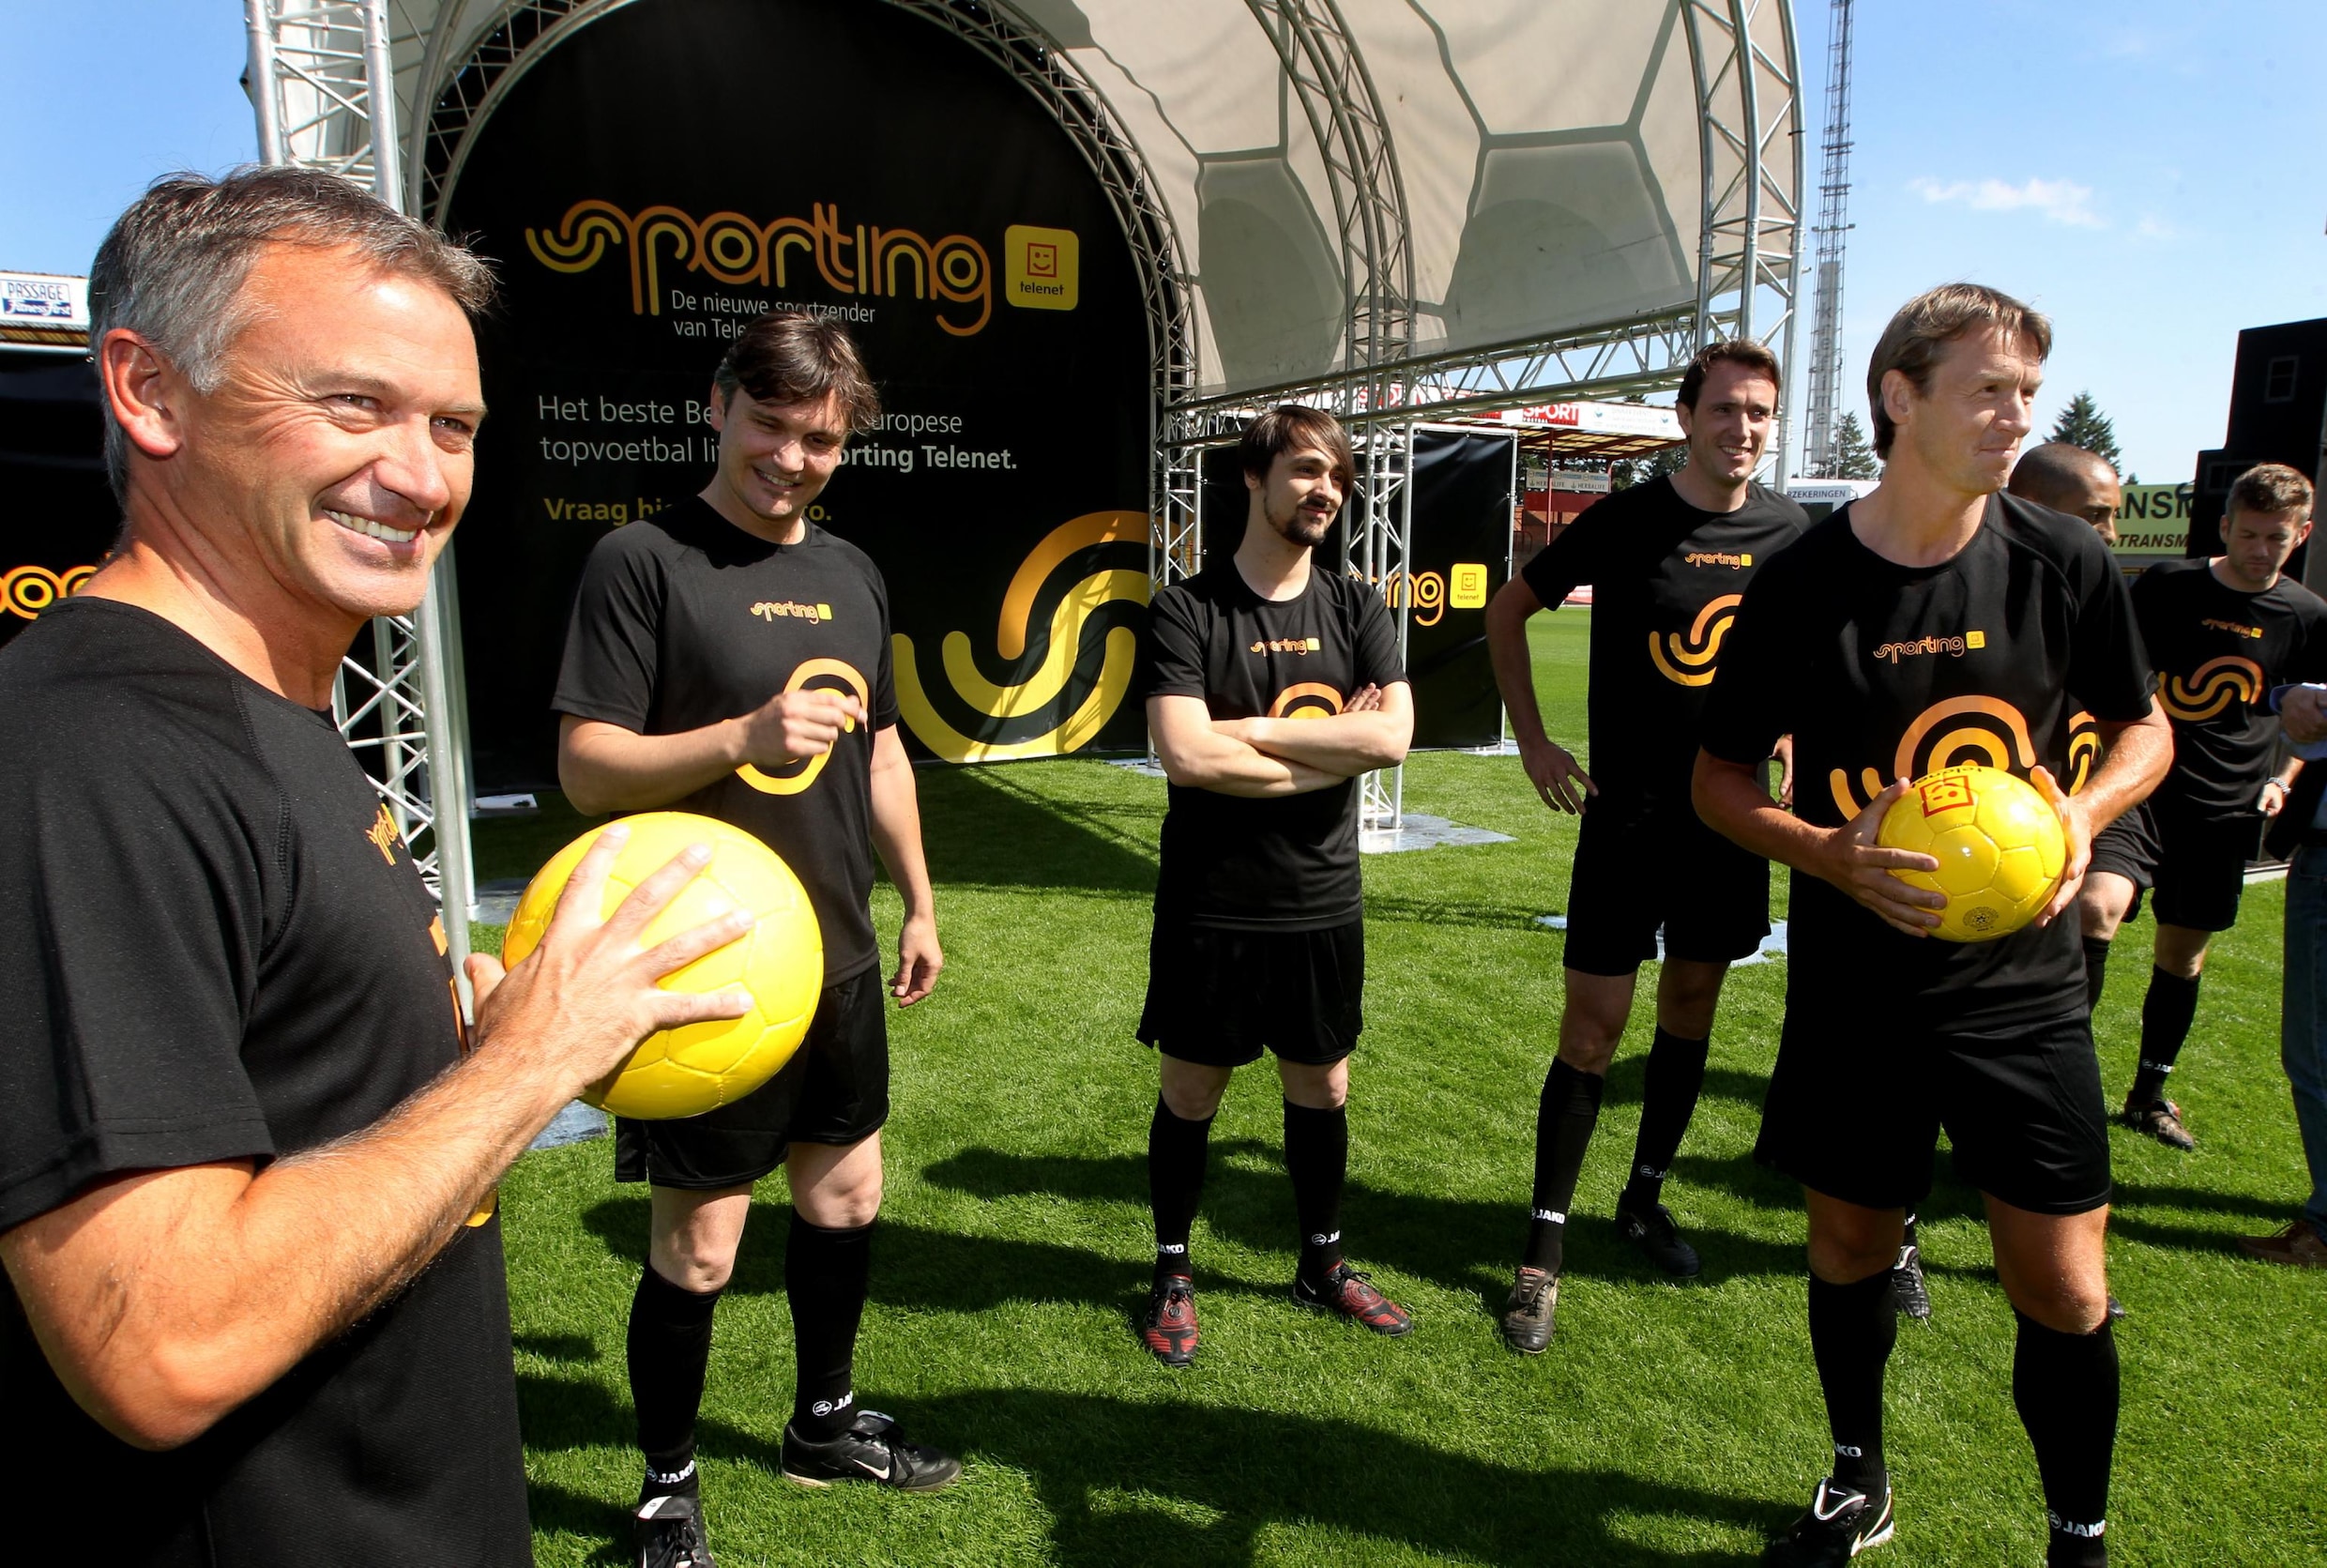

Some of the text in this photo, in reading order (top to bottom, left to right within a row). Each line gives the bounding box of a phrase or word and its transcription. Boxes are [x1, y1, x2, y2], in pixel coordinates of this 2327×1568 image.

[525, 200, 992, 337] sporting
[8, 282, 64, 300] PASSAGE
[1020, 281, 1065, 296] telenet
[671, 290, 696, 311] De
[704, 293, 768, 314] nieuwe
[674, 318, 747, 340] van Tele
[538, 395, 590, 421] Het
[600, 395, 675, 424] beste
[872, 412, 963, 437] uropese
[1524, 403, 1579, 420] SPORT
[540, 435, 692, 466] topvoetbal
[838, 443, 914, 473] orting
[921, 445, 1017, 469] Telenet.
[543, 497, 629, 525] Vraag
[1684, 552, 1741, 571] sporting
[750, 601, 819, 625] sporting
[1250, 638, 1308, 657] sporting
[1873, 635, 1965, 664] sporting
[1536, 1209, 1565, 1225] JAKO
[1157, 1242, 1184, 1255] AKO
[659, 1460, 695, 1484] JAKO
[2063, 1519, 2106, 1537] JAKO
